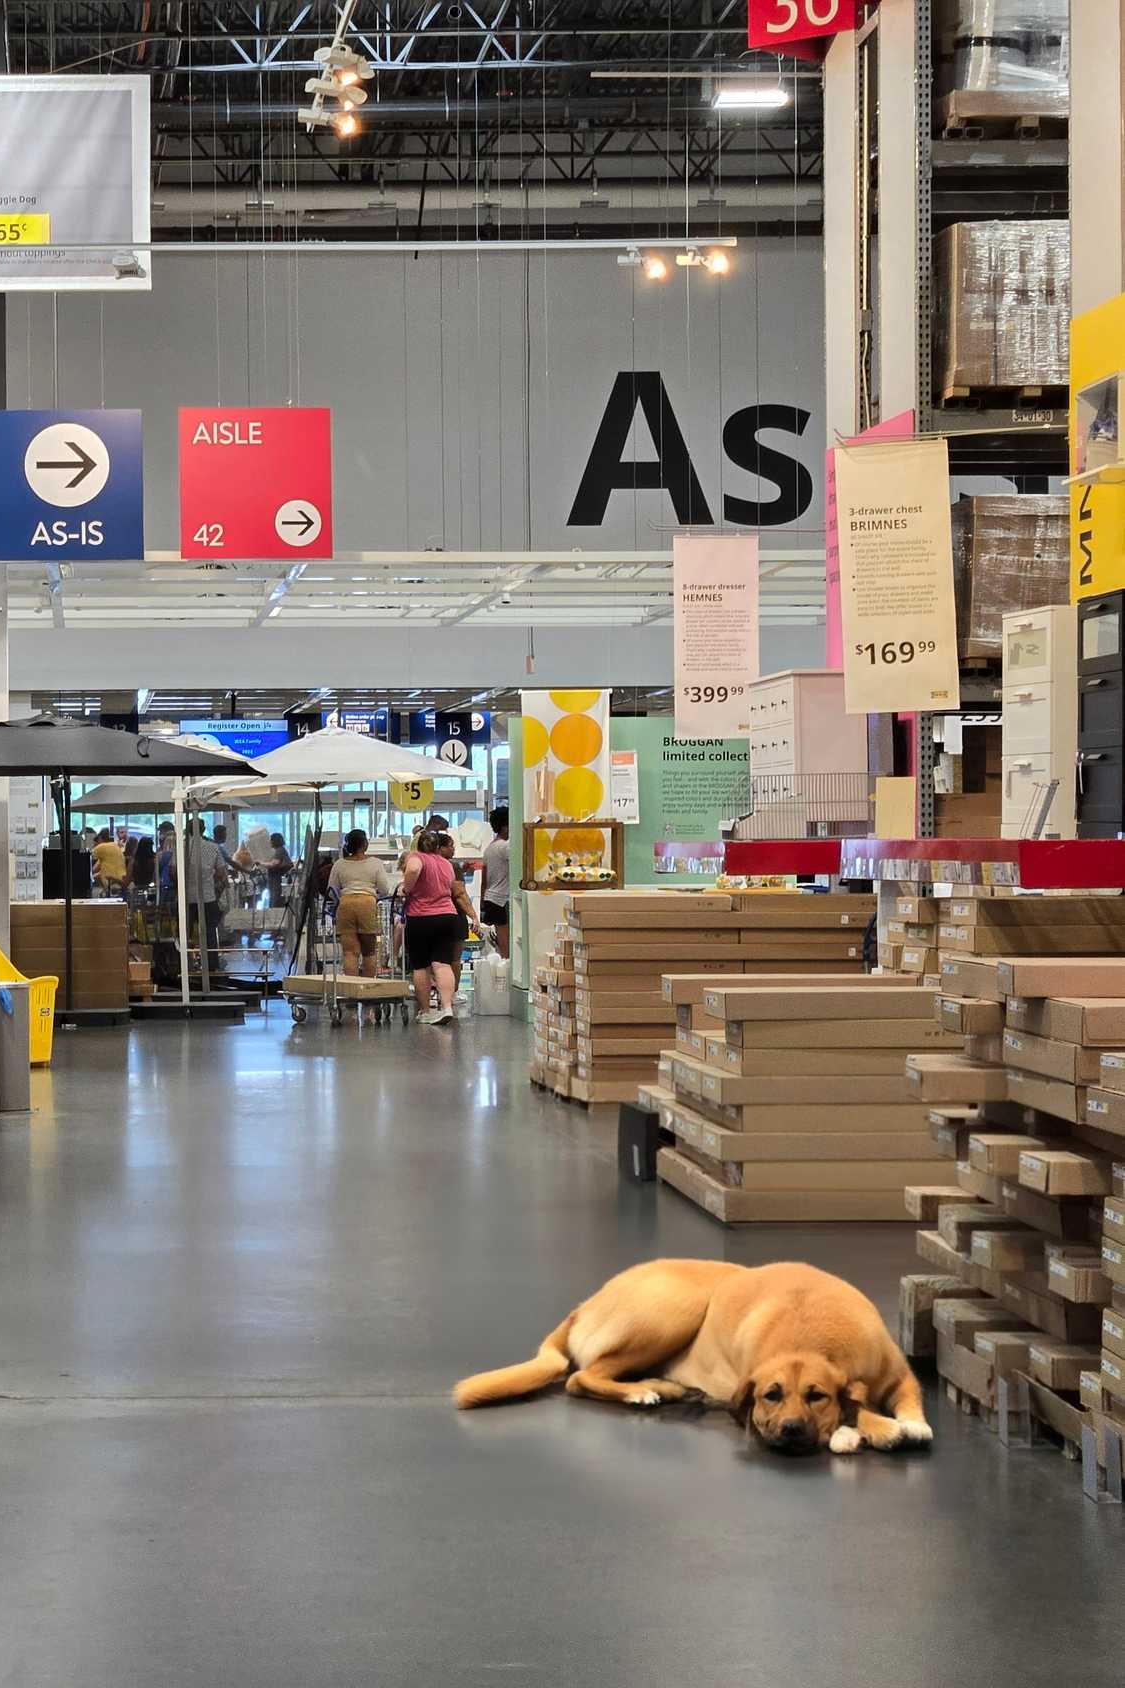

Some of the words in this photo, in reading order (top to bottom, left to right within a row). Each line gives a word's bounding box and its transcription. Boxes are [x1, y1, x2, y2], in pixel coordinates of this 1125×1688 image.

[19, 195, 37, 204] Dog
[192, 422, 263, 445] AISLE
[566, 371, 813, 526] As
[850, 506, 893, 516] 3-drawer
[896, 504, 923, 514] chest
[850, 519, 908, 531] BRIMNES
[30, 521, 105, 546] AS-IS
[193, 524, 225, 547] 42
[682, 583, 716, 591] 8-drawer
[682, 593, 723, 602] HEMNES
[295, 722, 310, 736] 14
[447, 721, 461, 736] 15
[662, 737, 724, 747] BROGGAN
[662, 751, 705, 761] limited
[708, 751, 749, 762] collect
[404, 782, 421, 800] $5
